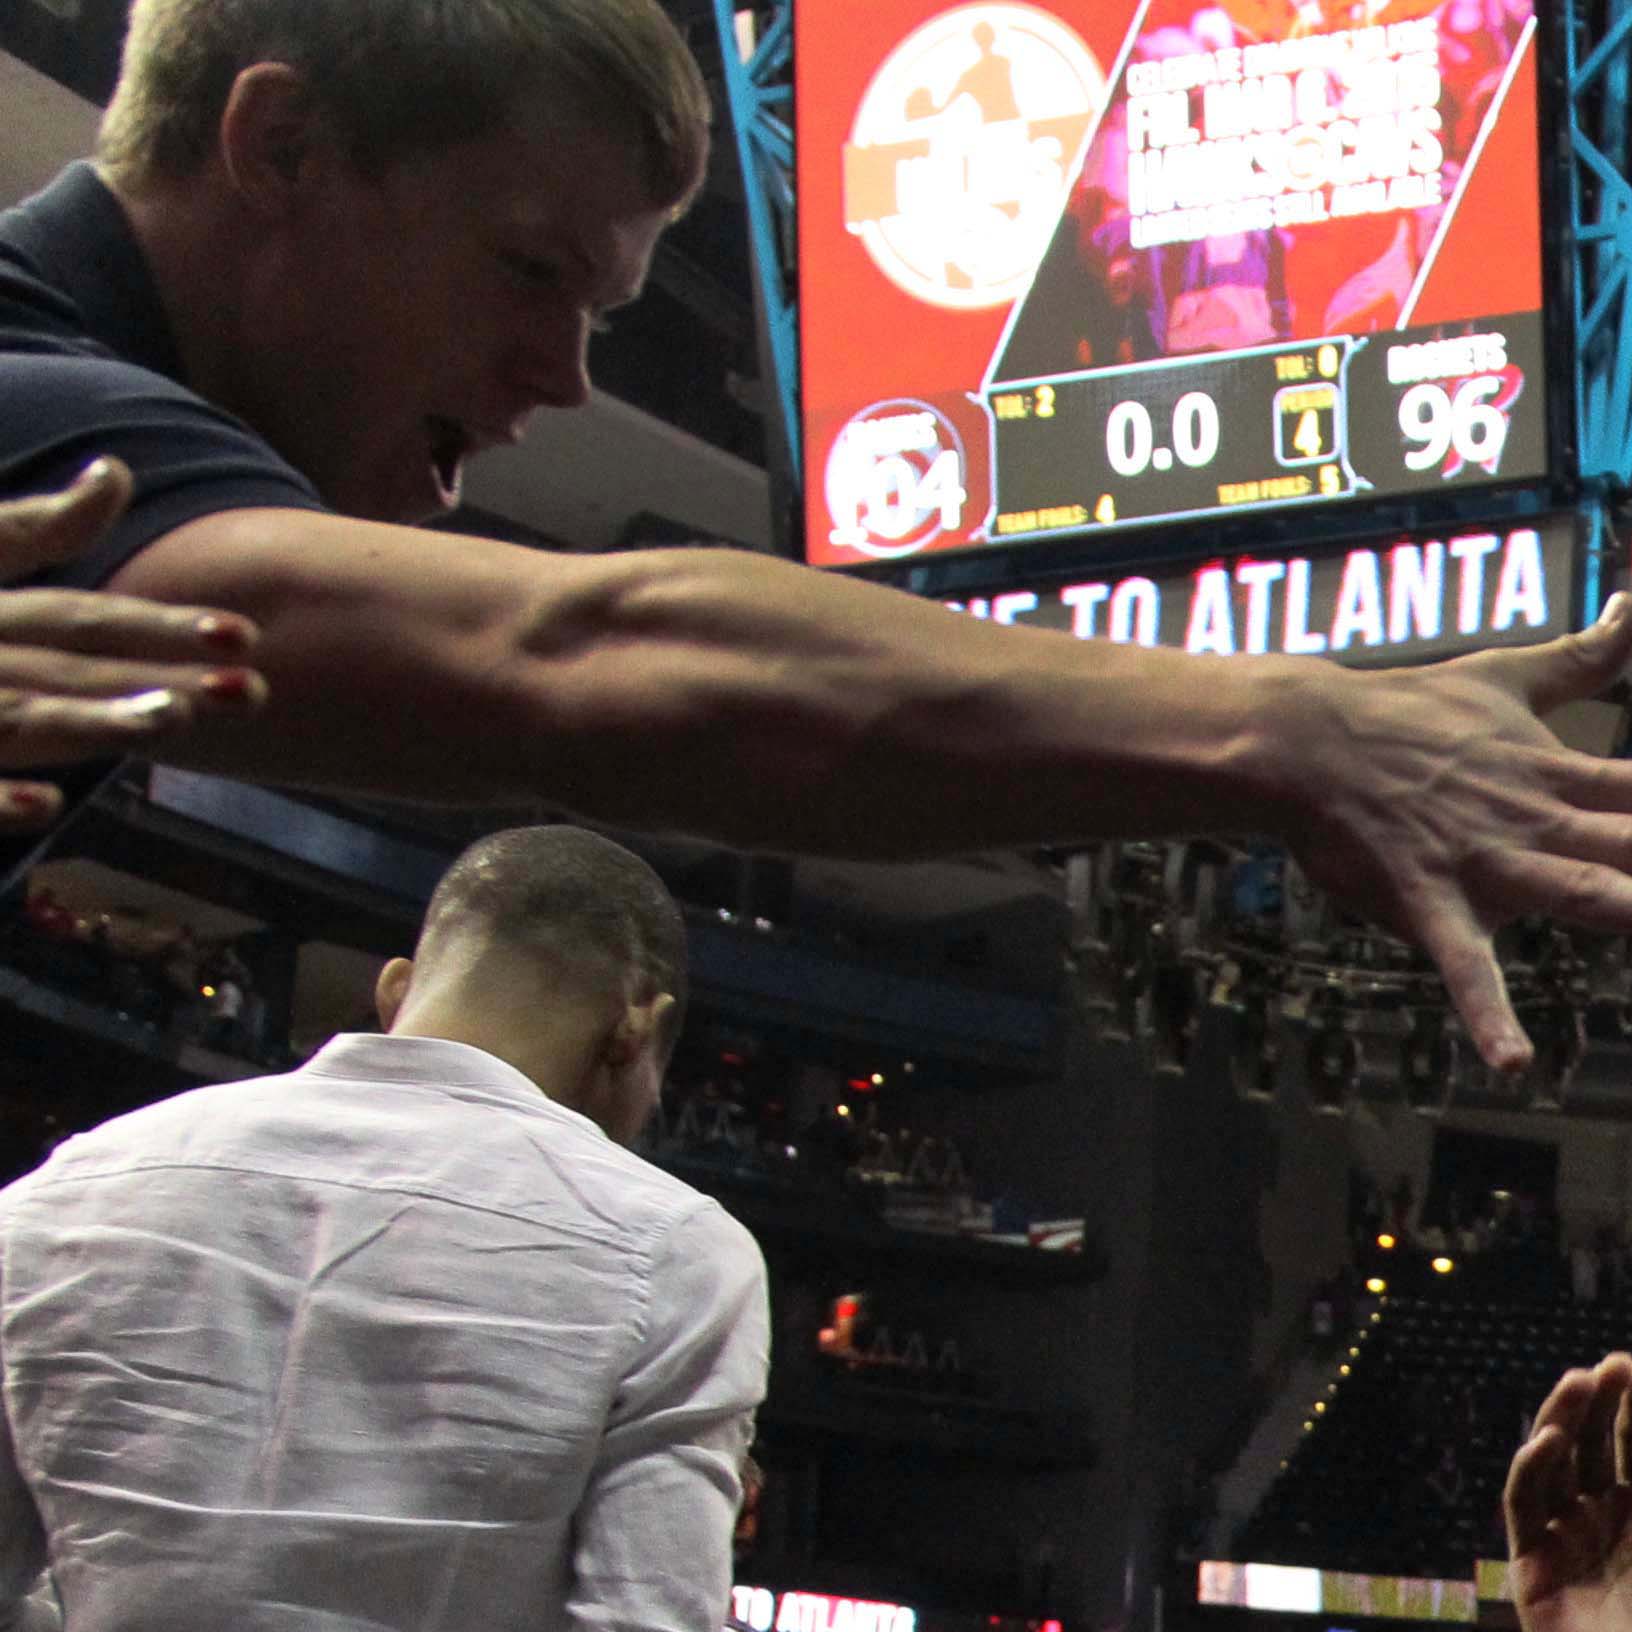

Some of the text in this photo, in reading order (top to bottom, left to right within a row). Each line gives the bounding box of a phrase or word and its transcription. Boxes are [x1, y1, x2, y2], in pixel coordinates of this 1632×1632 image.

[1035, 385, 1055, 418] 2
[1107, 392, 1219, 476] 0.0
[1293, 408, 1322, 457] 4
[1398, 376, 1506, 470] 96
[1095, 494, 1116, 525] 4
[1062, 529, 1549, 656] TO ATLANTA
